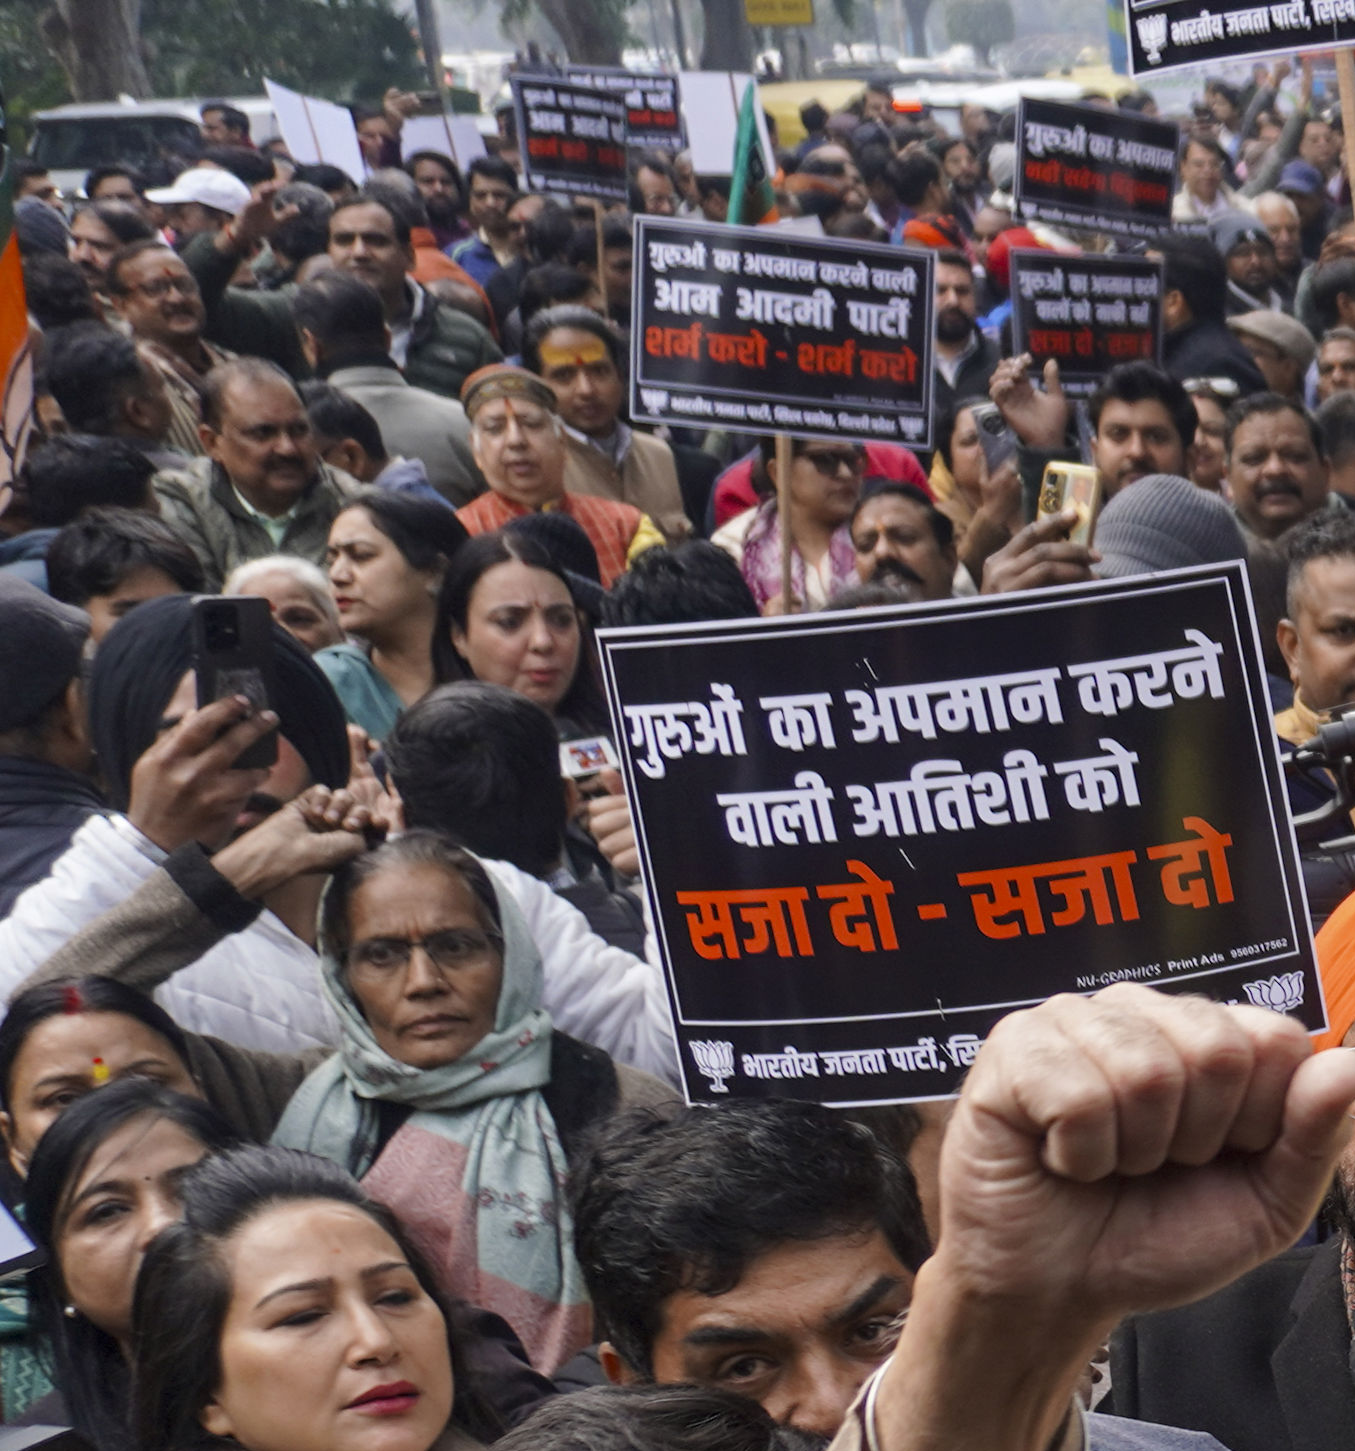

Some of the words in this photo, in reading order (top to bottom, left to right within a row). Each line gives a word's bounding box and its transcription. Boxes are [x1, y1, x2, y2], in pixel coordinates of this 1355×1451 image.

[1170, 8, 1225, 46] भारतीय
[1224, 6, 1271, 36] जनता
[713, 249, 740, 274] का
[744, 251, 816, 282] अपमान
[820, 261, 869, 290] करने
[871, 267, 917, 295] वाली
[654, 279, 722, 317] आम
[735, 287, 835, 330] आदमी
[847, 297, 911, 339] पार्टी
[645, 322, 704, 360] शर्म
[706, 329, 768, 368] करो
[797, 339, 856, 376] शर्म
[859, 346, 917, 384] करो
[623, 682, 748, 779] गुरुओं
[759, 692, 837, 751] का
[844, 667, 1064, 743] अपमान
[1067, 628, 1226, 716] करने
[716, 770, 839, 848] वाली
[845, 749, 1051, 837] आतिशी
[1053, 737, 1141, 813] को
[676, 886, 815, 960] सजा
[815, 859, 899, 952] दो
[956, 850, 1141, 940] सजा
[1146, 815, 1235, 909] दो
[1076, 963, 1162, 988] NU-GRAPHICS
[1167, 954, 1199, 972] Print
[1200, 953, 1225, 966] Ads
[1230, 938, 1288, 959] 9560317562
[742, 1045, 820, 1080] भारतीय
[819, 1049, 888, 1076] जनता
[887, 1037, 946, 1074] पार्टी,
